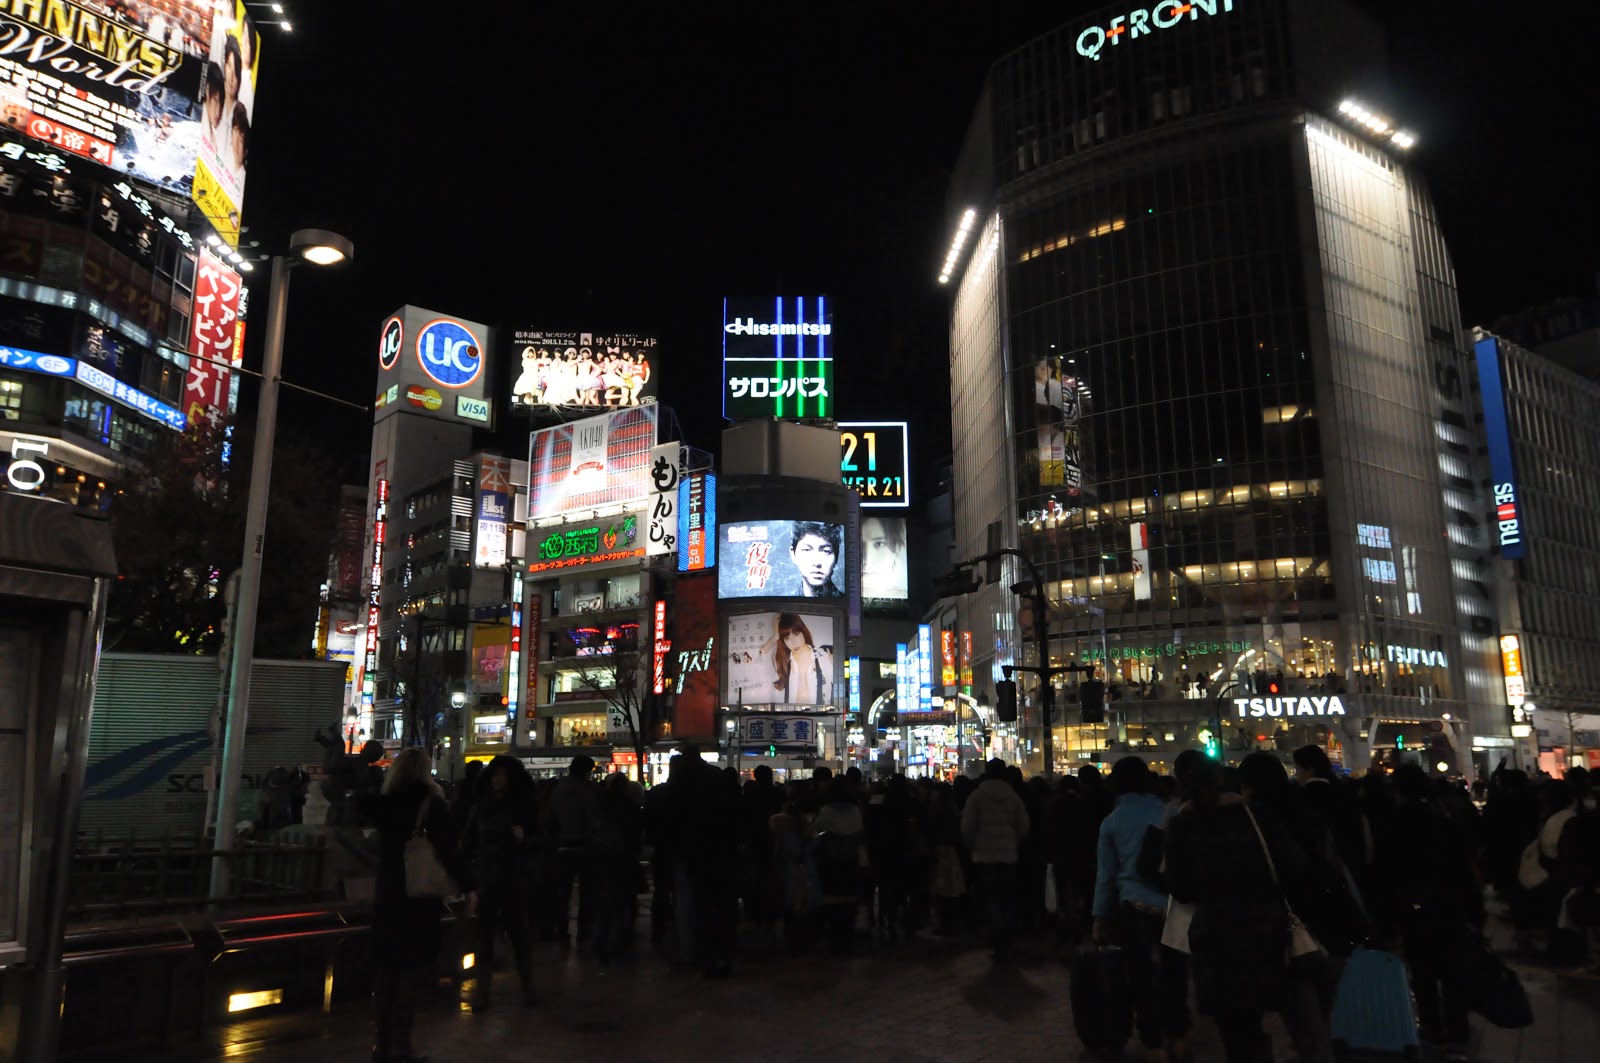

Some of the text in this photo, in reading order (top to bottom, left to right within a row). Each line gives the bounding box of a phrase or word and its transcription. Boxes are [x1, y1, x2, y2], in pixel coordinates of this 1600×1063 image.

[729, 377, 828, 397] サロンパス
[461, 402, 487, 417] VISA
[840, 432, 877, 471] 21
[882, 476, 902, 496] 21
[651, 455, 677, 550] もんじゃ
[1494, 482, 1520, 546] SEIBU
[689, 477, 702, 564] 三千里薬品
[1233, 695, 1345, 718] TSUTAYA
[733, 720, 817, 740] 盛堂書
